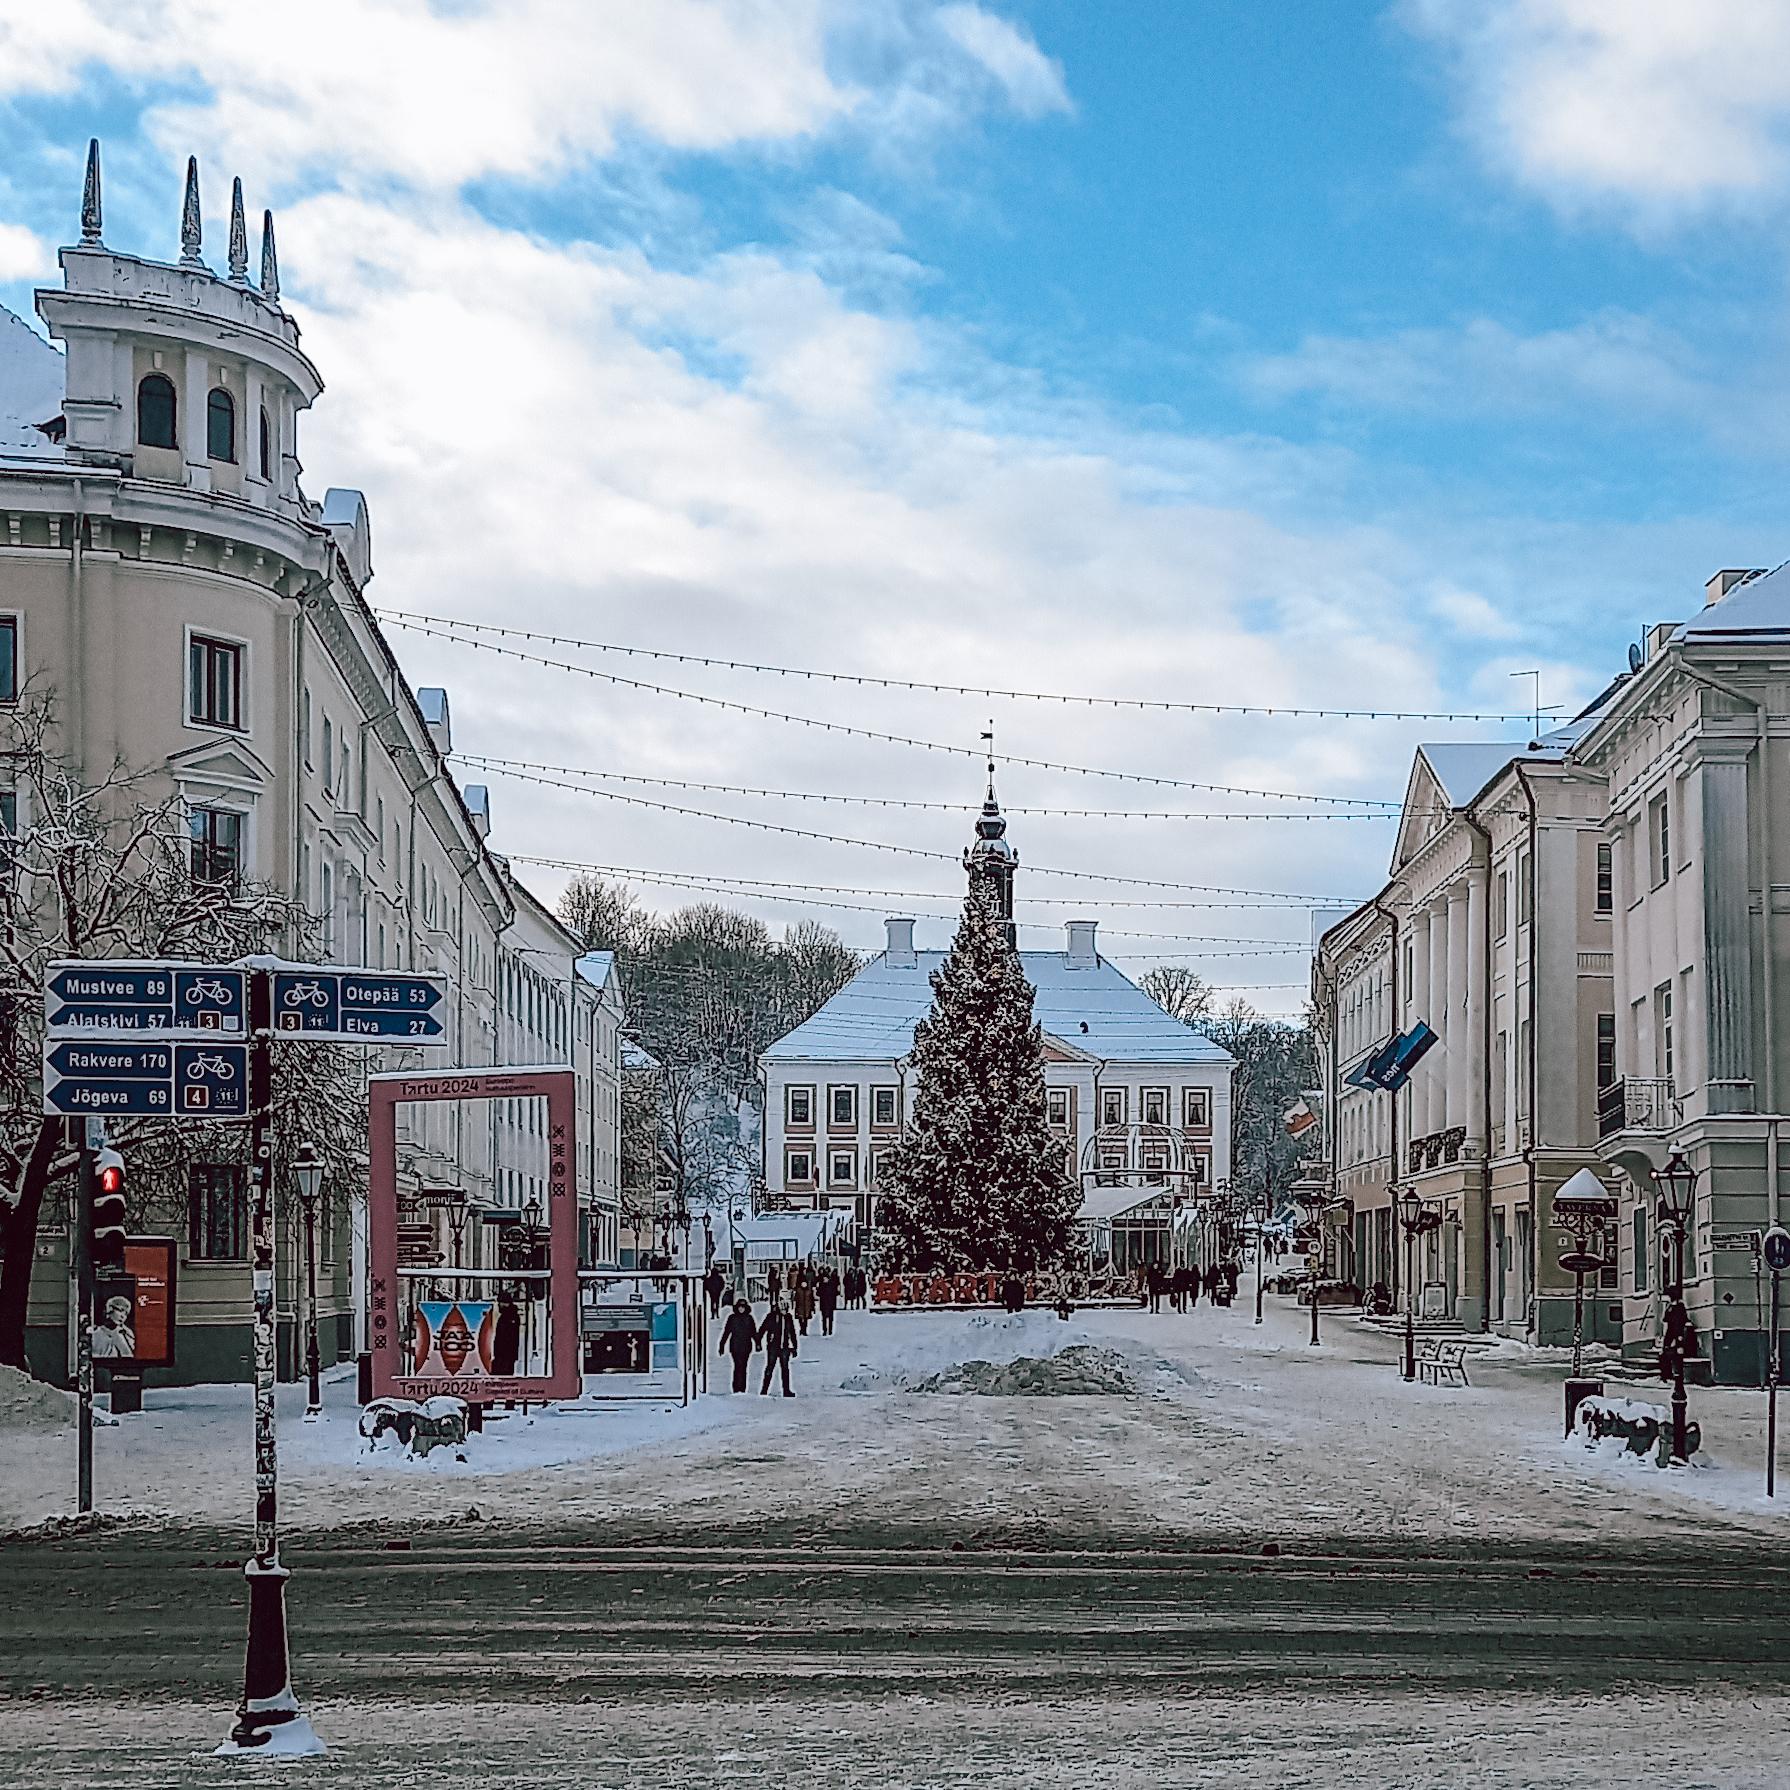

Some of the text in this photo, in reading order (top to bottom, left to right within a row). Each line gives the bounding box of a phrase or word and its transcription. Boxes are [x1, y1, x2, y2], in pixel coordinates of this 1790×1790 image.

[66, 979, 166, 995] Mustvee 89
[346, 986, 426, 1004] Otepää 53
[67, 1013, 166, 1028] Alatskivi 57
[205, 1016, 214, 1029] 3
[286, 1016, 295, 1030] 3
[346, 1018, 427, 1034] Elva 27
[69, 1052, 167, 1069] Rakvere 170
[400, 1080, 479, 1095] Tartu 2024
[71, 1089, 167, 1108] Jõgeva 69
[192, 1089, 201, 1104] 4
[400, 1381, 479, 1396] Tartu 2024
